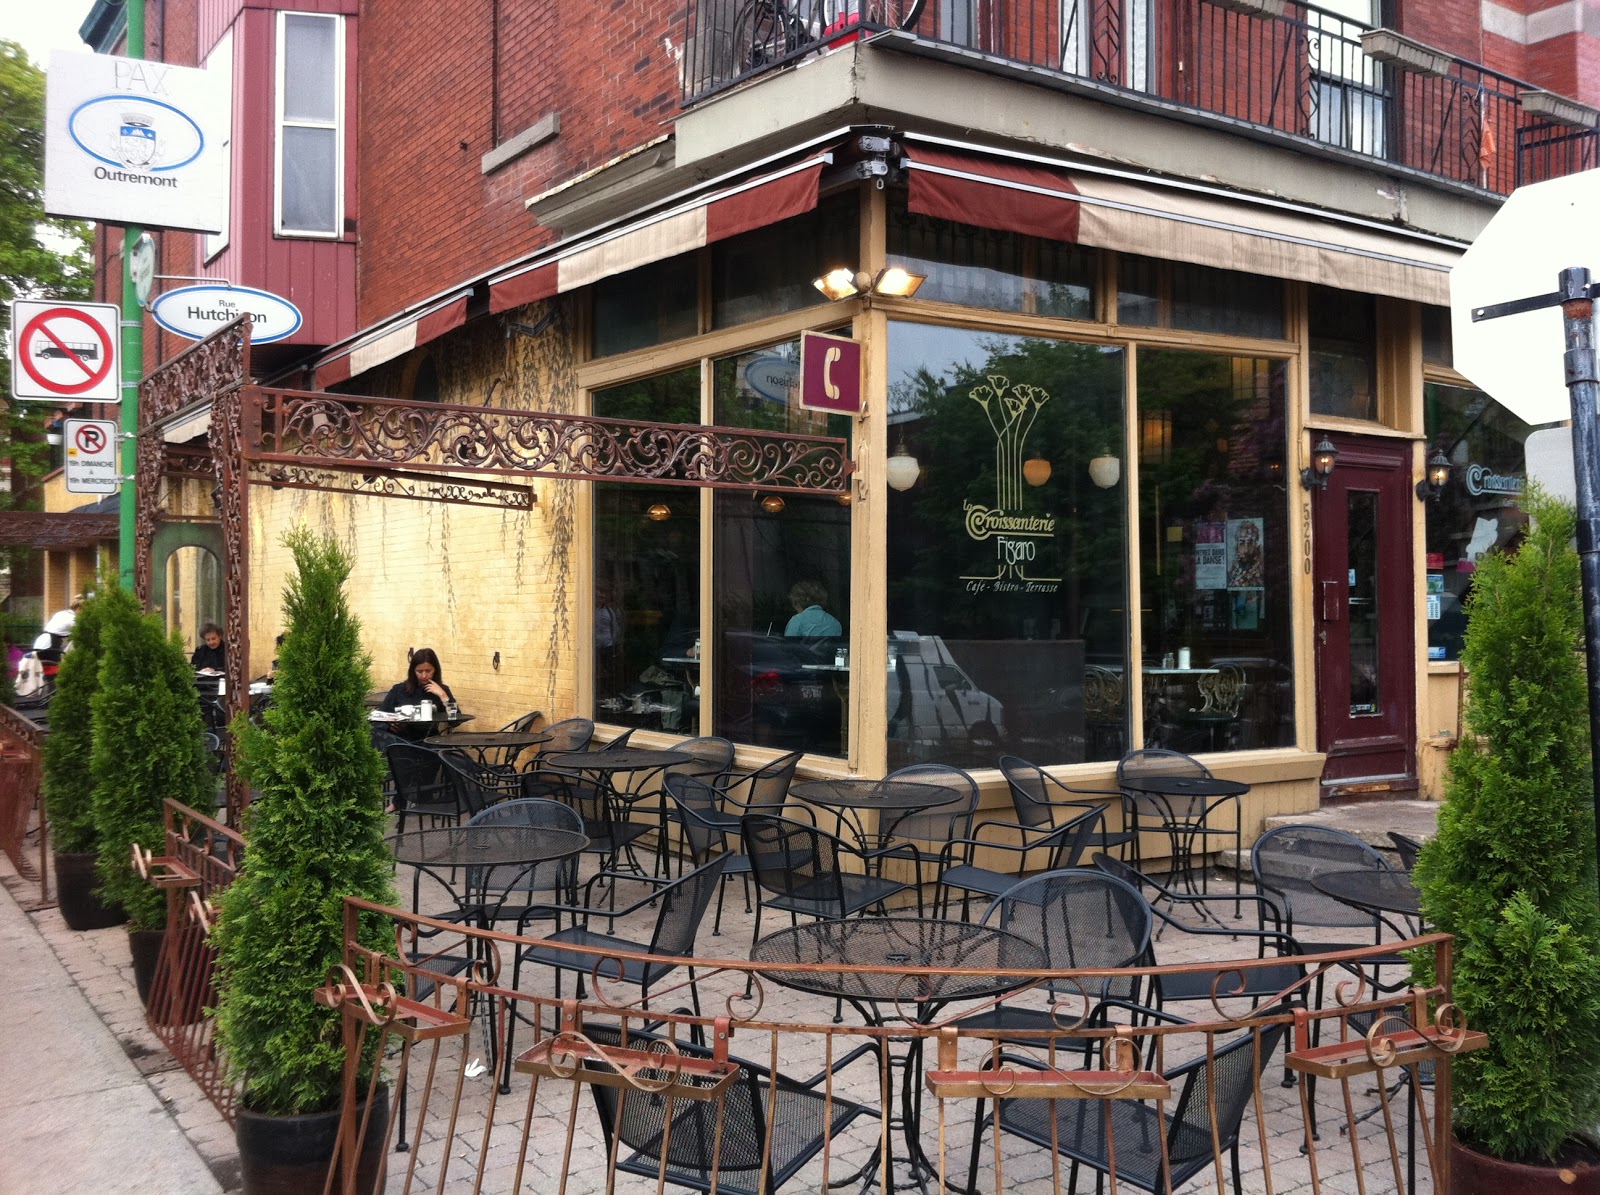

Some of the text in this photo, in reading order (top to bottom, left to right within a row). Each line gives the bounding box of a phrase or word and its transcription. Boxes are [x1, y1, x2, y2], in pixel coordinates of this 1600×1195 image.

[114, 60, 174, 95] PAX
[94, 166, 178, 188] Outremont
[187, 306, 267, 323] Hutchion
[218, 300, 236, 308] Rue
[966, 505, 1055, 540] Croissanterie
[997, 536, 1036, 565] Figaro
[1303, 503, 1311, 575] 5200
[966, 580, 985, 595] Café
[993, 581, 1019, 592] Bistro
[1026, 581, 1058, 592] Terrasse
